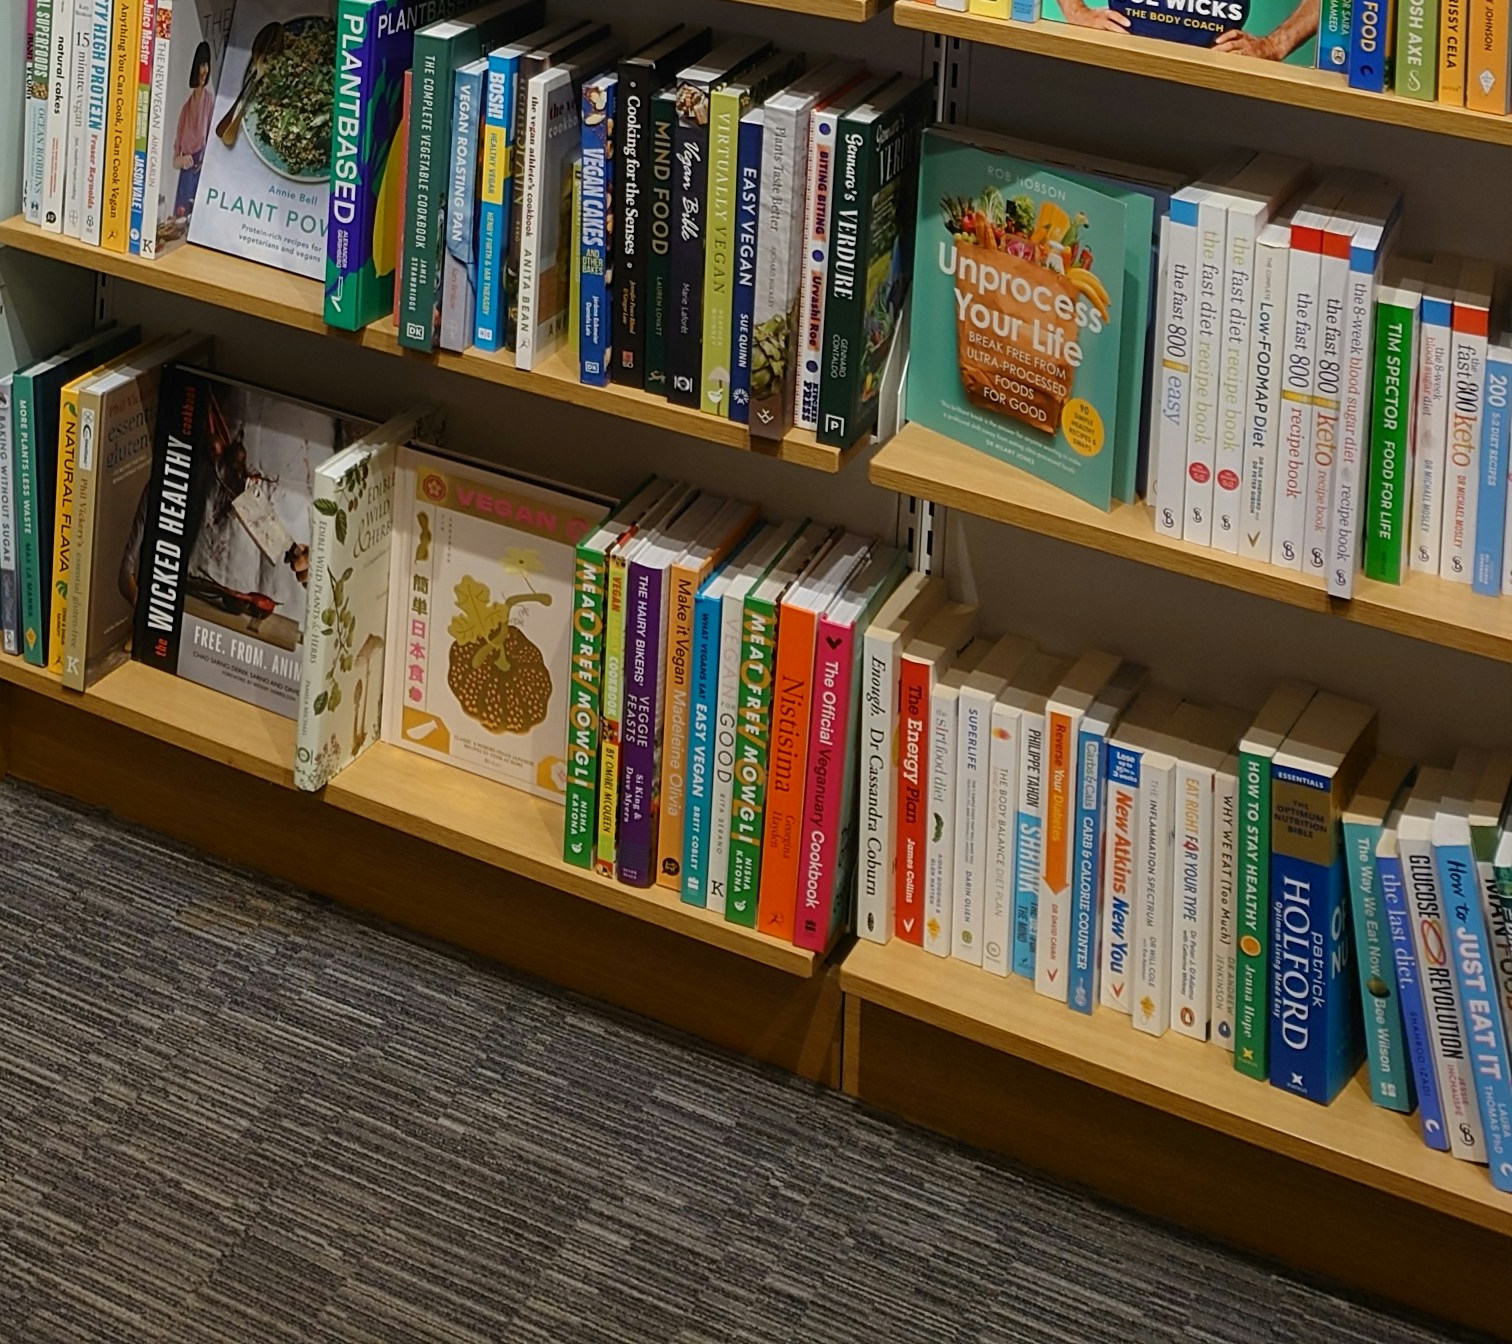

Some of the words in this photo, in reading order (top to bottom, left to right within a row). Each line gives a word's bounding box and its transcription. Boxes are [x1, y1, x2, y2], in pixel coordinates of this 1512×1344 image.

[1125, 8, 1146, 20] THE
[1149, 12, 1180, 27] BODY
[1183, 17, 1224, 32] COACH
[334, 13, 364, 224] PLANTBASED
[205, 188, 277, 223] PLANT
[939, 242, 1103, 333] Unprocess
[953, 287, 1024, 341] Your
[1034, 328, 1084, 366] Life
[966, 347, 1067, 397] ULTRA-PROCESSED
[983, 387, 1010, 406] FOR
[1011, 398, 1047, 422] GOOD
[995, 375, 1035, 400] FOODS
[160, 437, 193, 534] HEALTHY
[456, 487, 557, 530] VEGAN
[148, 540, 183, 632] WICKED
[776, 675, 805, 792] Nistisima
[1278, 771, 1324, 789] ESSENTIALS
[1280, 878, 1312, 1049] HOLFORD
[1409, 855, 1440, 920] GLUCOSE
[1428, 966, 1463, 1060] REVOLUTION
